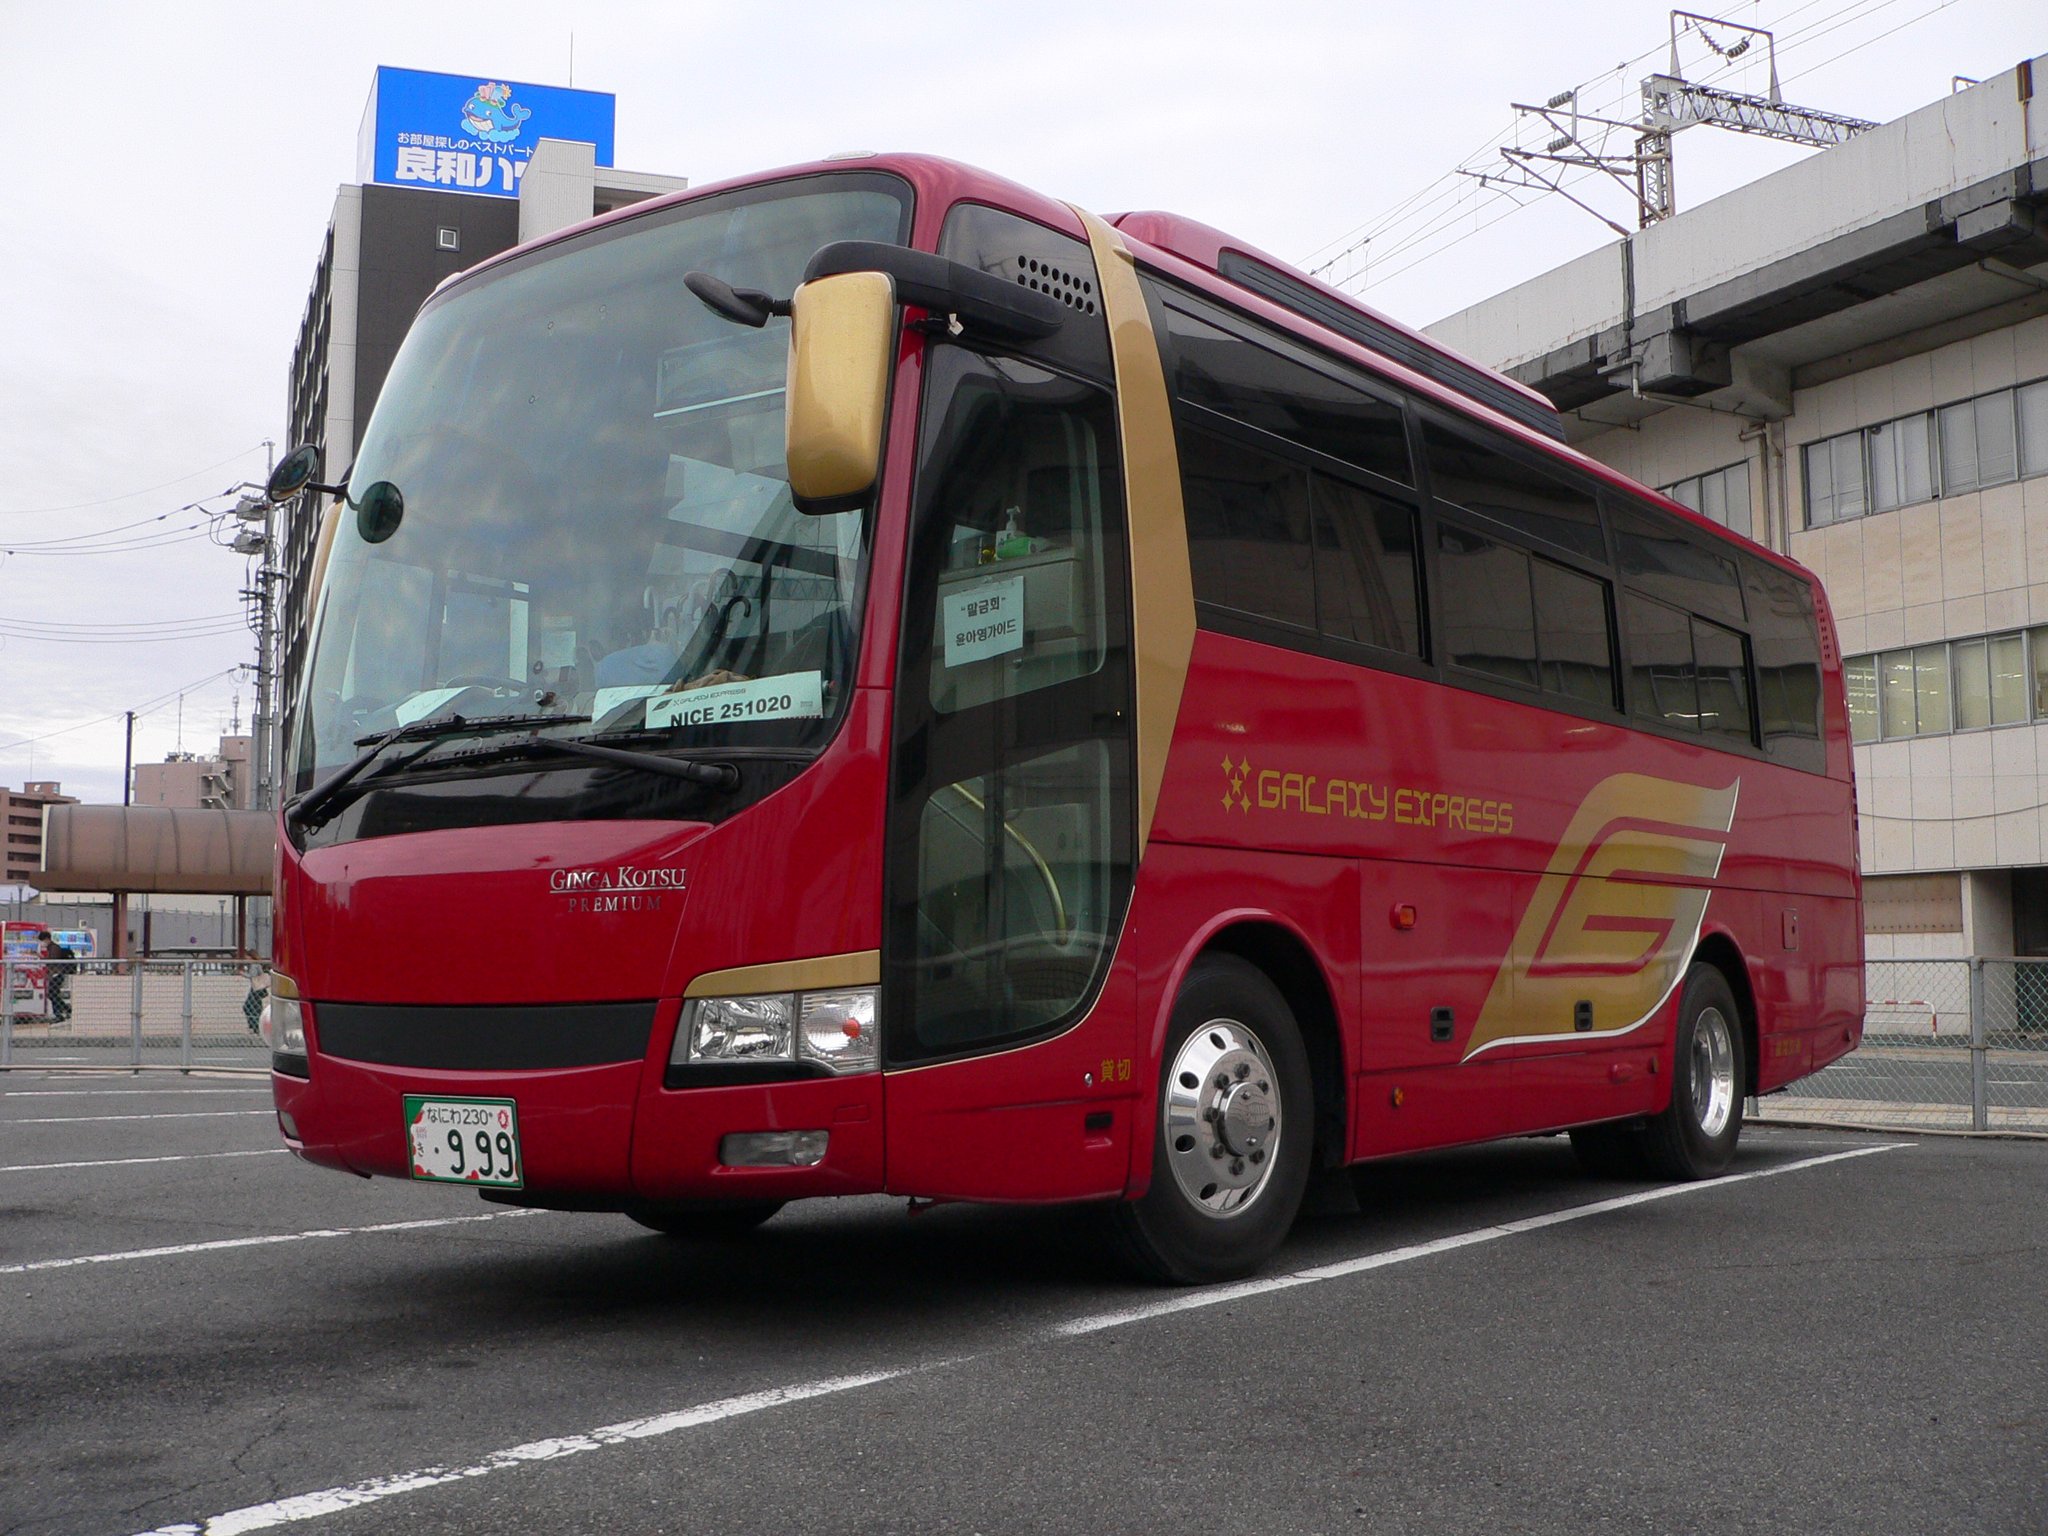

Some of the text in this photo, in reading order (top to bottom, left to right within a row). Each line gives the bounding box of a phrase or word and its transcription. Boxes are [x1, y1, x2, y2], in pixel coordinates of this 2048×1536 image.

[670, 694, 792, 727] NICE 251020
[1257, 769, 1514, 836] GALAXY EXPRESS
[550, 866, 687, 890] GINGA KOTSU
[568, 896, 662, 913] PREMIUM
[1100, 1058, 1132, 1083] 貸切
